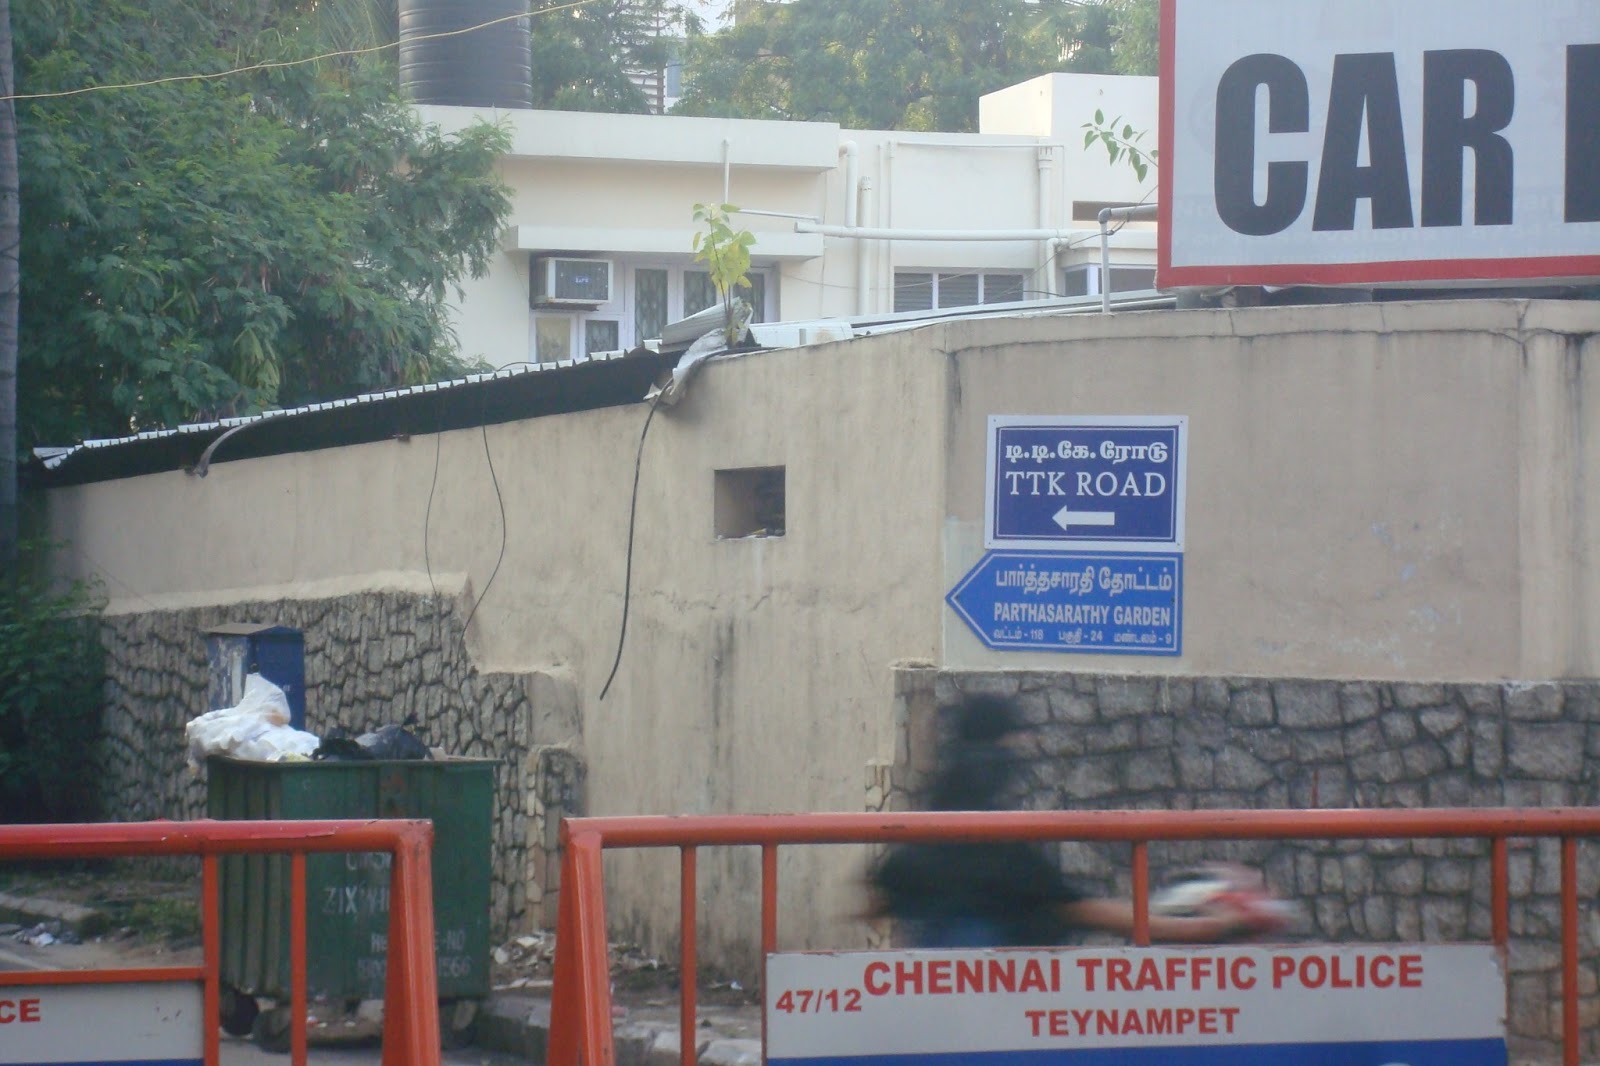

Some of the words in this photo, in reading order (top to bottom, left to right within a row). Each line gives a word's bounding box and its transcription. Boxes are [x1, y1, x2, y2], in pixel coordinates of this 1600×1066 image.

[1214, 48, 1514, 236] CAR
[1005, 471, 1066, 496] TTK
[1076, 471, 1166, 497] ROAD
[995, 563, 1094, 596] பார்த்தசாரதி
[1099, 566, 1173, 597] தோட்டம்
[994, 602, 1110, 625] PARTHASARATHY
[1113, 605, 1171, 626] GARDEN
[863, 958, 1060, 996] CHENNAI
[1076, 956, 1257, 992] TRAFFIC
[1272, 955, 1424, 990] POLICE
[775, 988, 862, 1014] 47/12
[1025, 1007, 1240, 1037] TEYNAMPET
